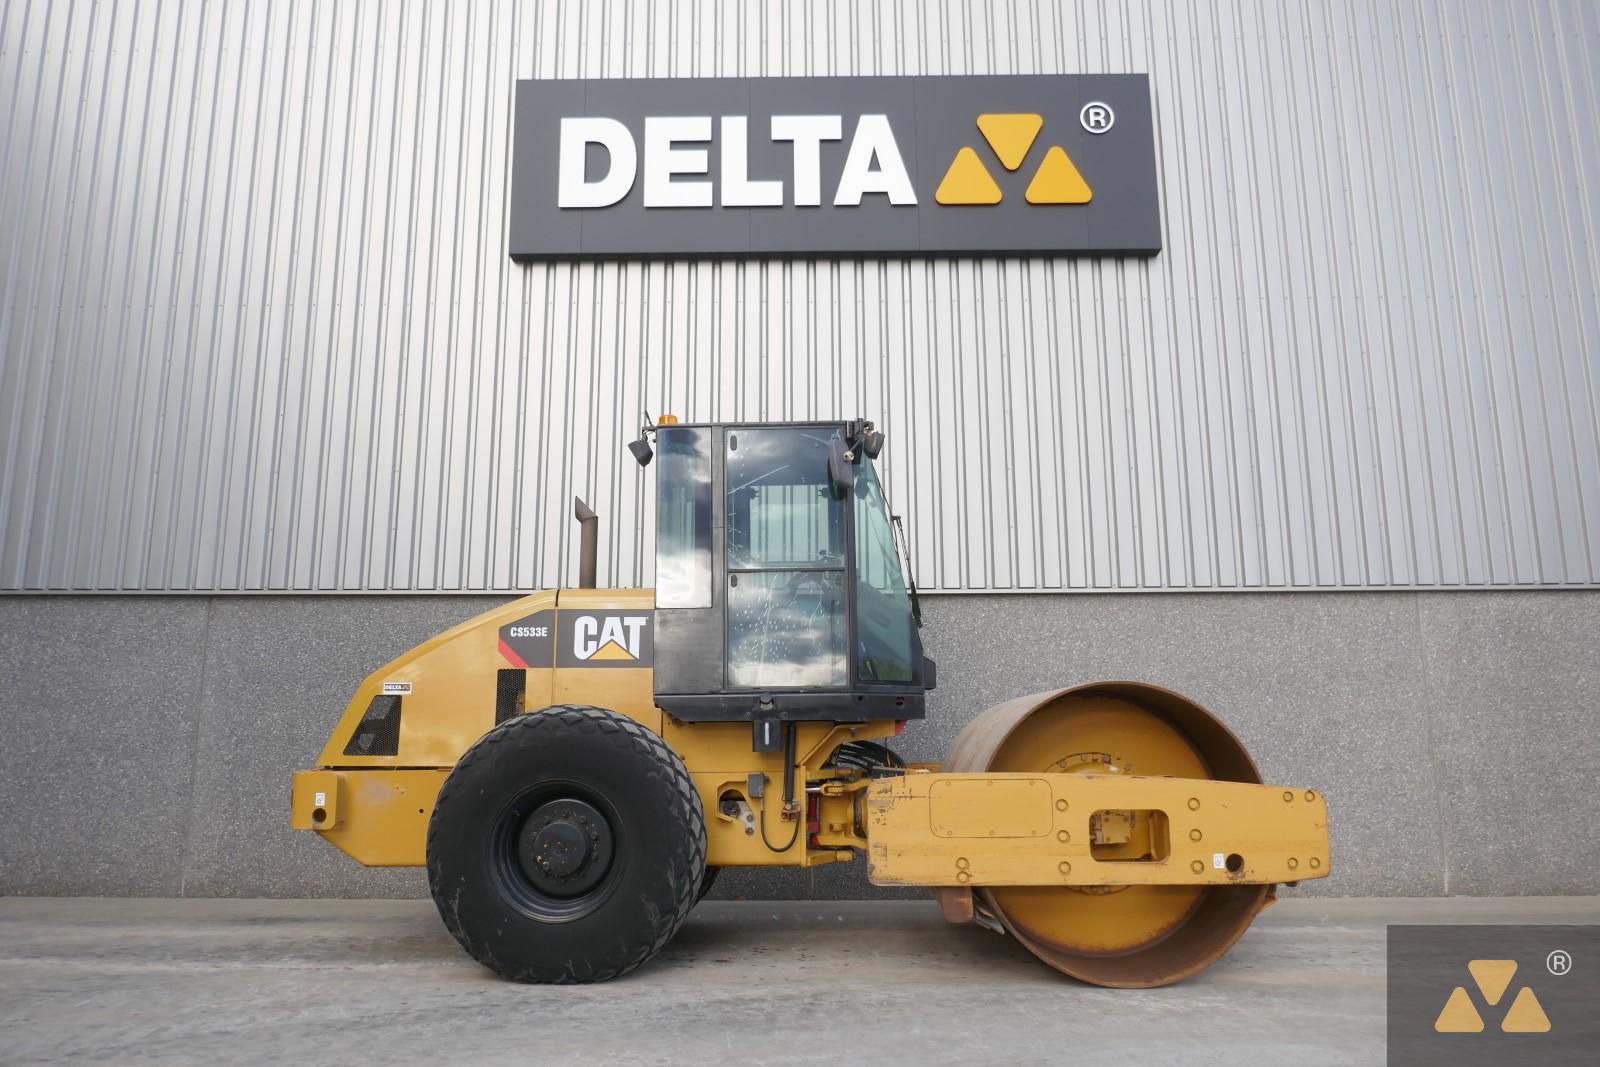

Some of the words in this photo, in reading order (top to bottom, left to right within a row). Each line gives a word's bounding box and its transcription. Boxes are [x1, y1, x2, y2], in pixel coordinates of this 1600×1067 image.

[557, 114, 918, 208] DELTA
[510, 626, 548, 637] CS533E
[574, 616, 647, 660] CAT
